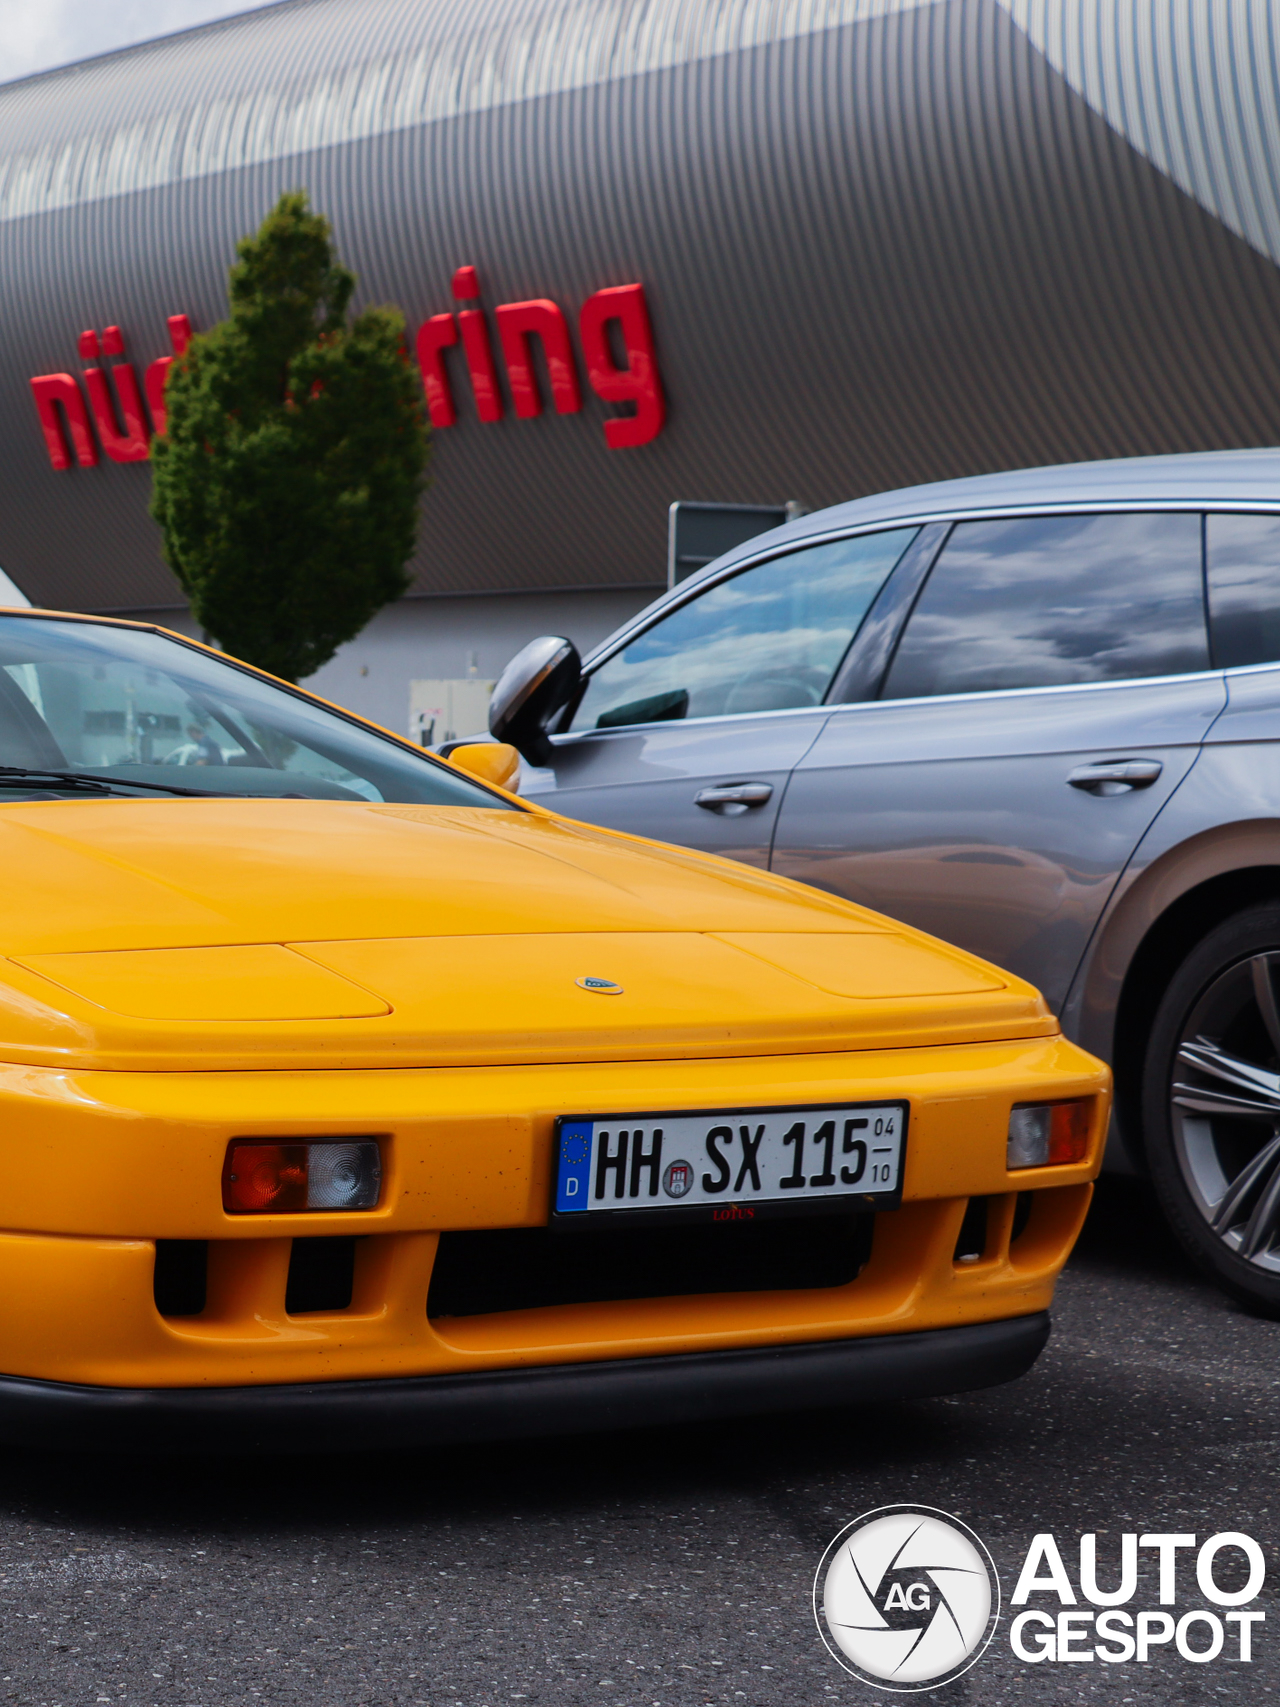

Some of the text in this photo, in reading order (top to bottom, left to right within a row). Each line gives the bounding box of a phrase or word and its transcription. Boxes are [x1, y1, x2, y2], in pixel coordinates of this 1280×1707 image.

[30, 265, 666, 470] nürring
[873, 1117, 895, 1137] 04
[595, 1117, 869, 1200] HH SX 115
[871, 1163, 891, 1183] 10
[565, 1177, 580, 1197] D
[712, 1207, 755, 1221] LOTUS
